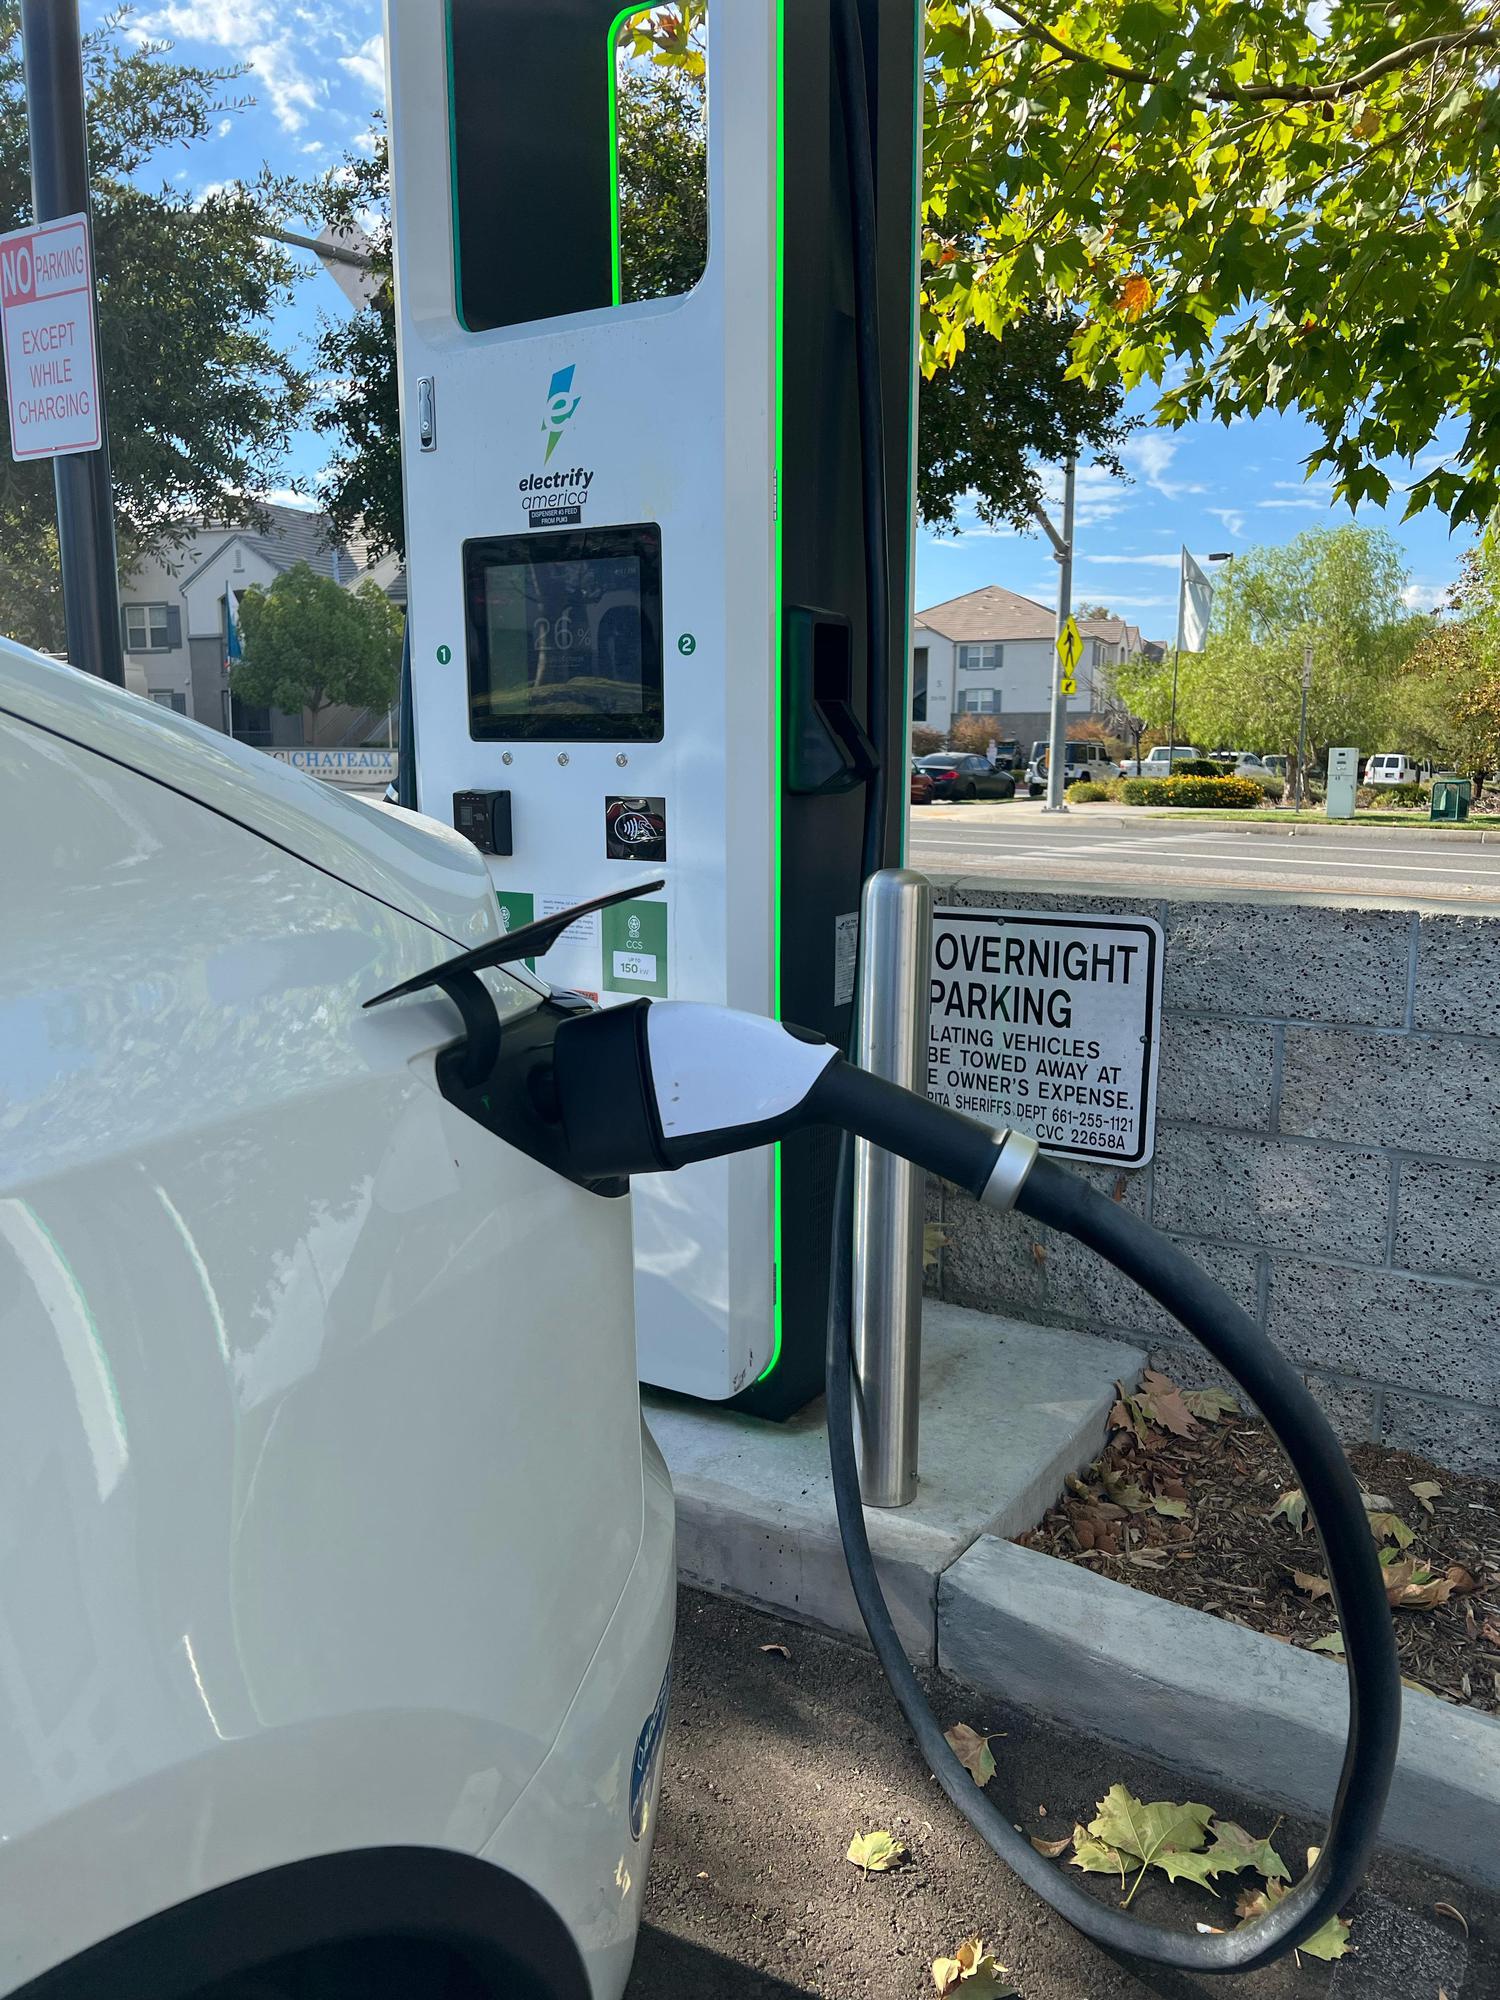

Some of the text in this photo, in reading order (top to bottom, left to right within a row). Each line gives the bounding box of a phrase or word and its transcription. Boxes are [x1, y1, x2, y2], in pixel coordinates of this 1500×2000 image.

[1, 246, 84, 298] NO PARKING
[22, 321, 75, 355] EXCEPT
[30, 358, 72, 388] WHILE
[18, 390, 90, 424] CHARGING
[519, 467, 594, 491] electrify
[521, 489, 589, 510] america
[682, 638, 692, 652] 2
[291, 752, 392, 768] CHATEAUX
[625, 940, 643, 950] CCS
[935, 932, 1138, 985] OVERNIGHT
[620, 963, 638, 974] 150
[930, 979, 1072, 1028] PARKING
[1003, 1031, 1100, 1059] VEHICLES
[928, 1046, 1122, 1084] BE TOWED AWAY AT
[947, 1070, 1029, 1096] OWNER'S
[1038, 1081, 1134, 1111] EXPENSE.
[955, 1095, 1011, 1116] SHERIFFS
[1017, 1103, 1047, 1120] DEPT
[1052, 1108, 1134, 1132] 661-255-1121
[1036, 1124, 1126, 1150] CVC 22658A
